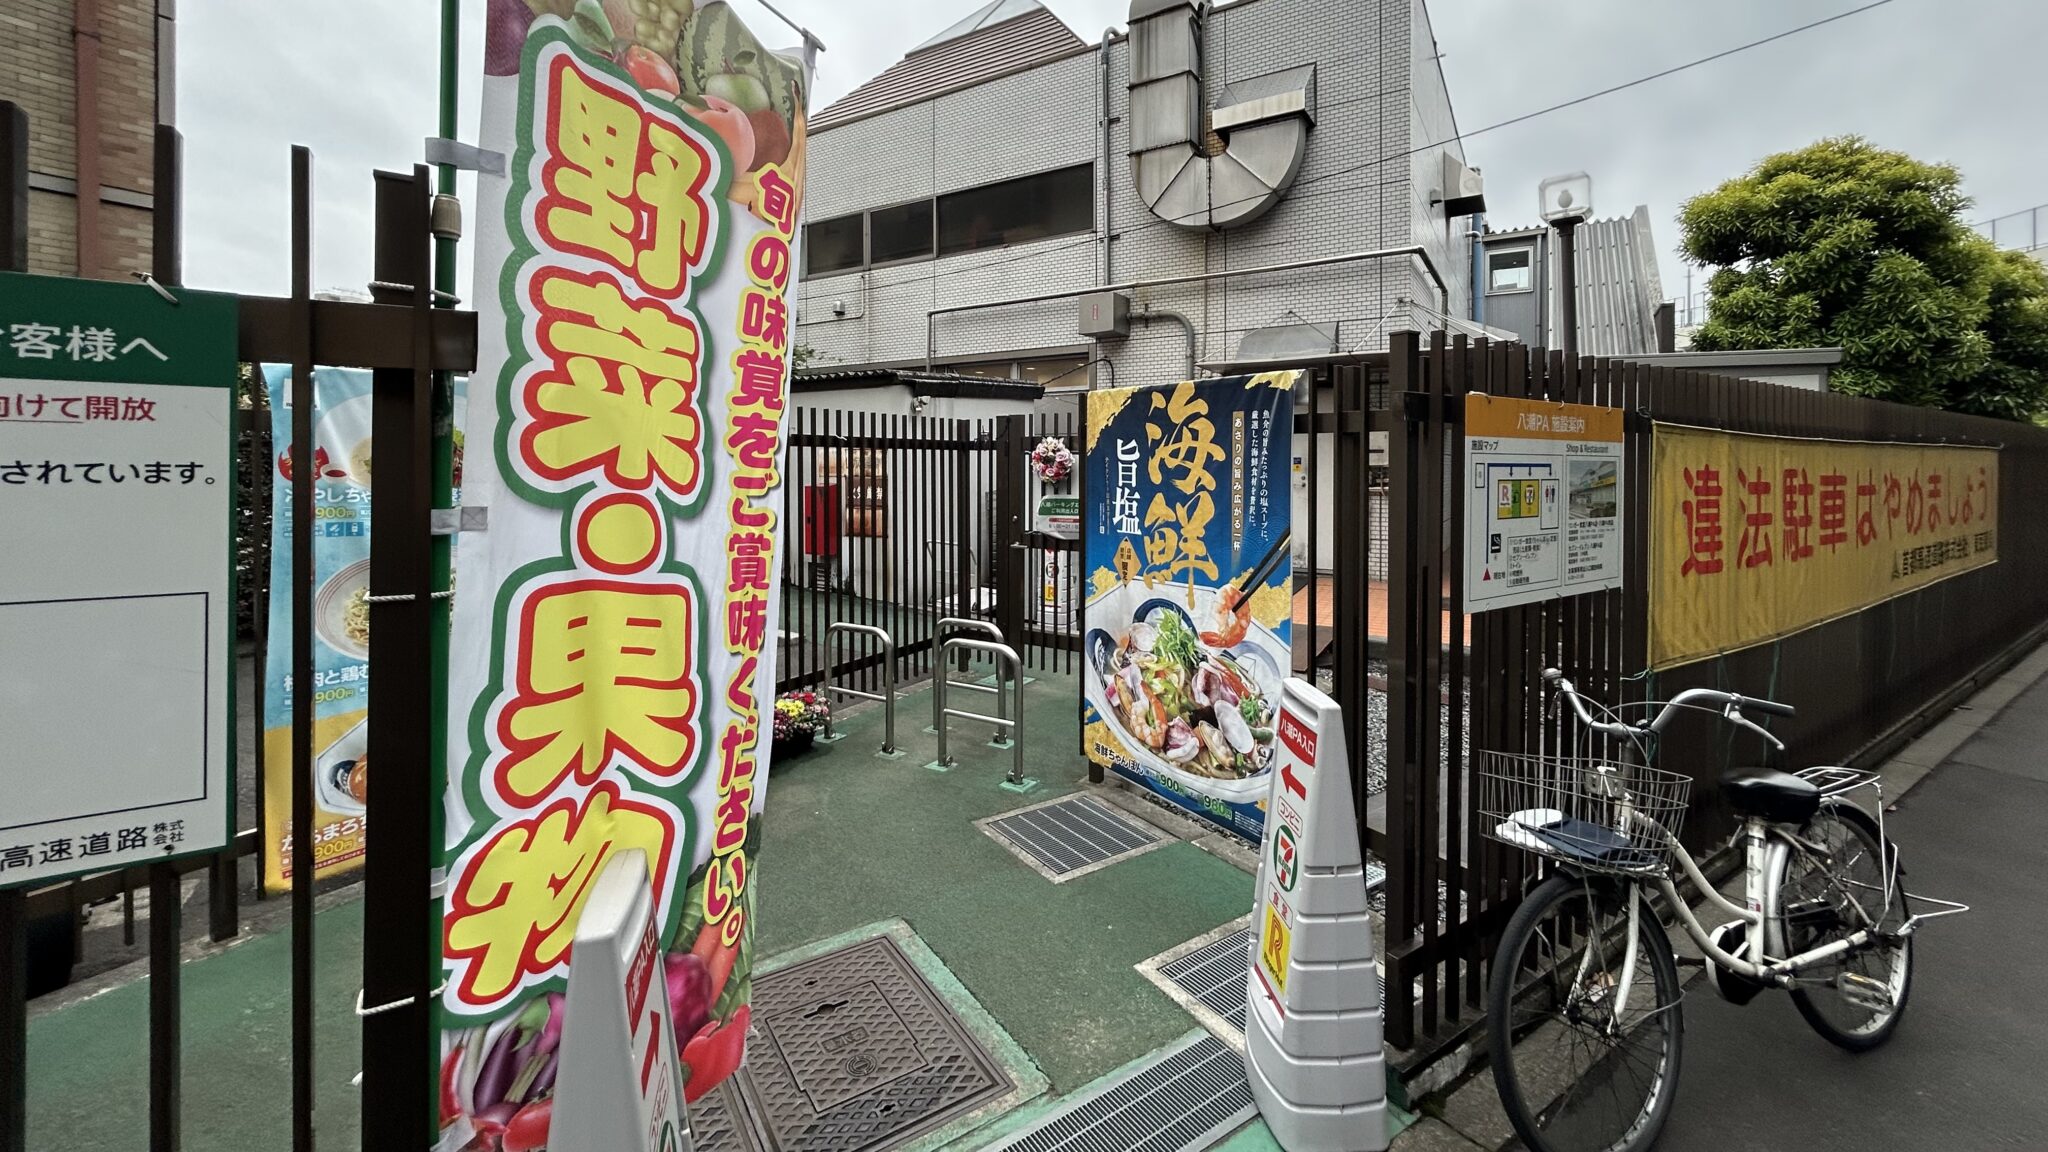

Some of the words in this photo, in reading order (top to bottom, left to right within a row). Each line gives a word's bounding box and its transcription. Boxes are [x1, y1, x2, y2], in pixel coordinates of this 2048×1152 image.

[0, 322, 170, 362] 客様へ
[0, 460, 215, 485] されています。
[1112, 438, 1142, 535] 旨塩
[1144, 381, 1226, 610] 海鮮
[1233, 417, 1242, 551] あさりの旨み広がる一杯
[1681, 464, 1988, 578] 違法駐車はやめましょう
[705, 165, 795, 944] 旬の味覚をご賞味ください。
[1094, 742, 1144, 776] 海鮮ちゃんぽん
